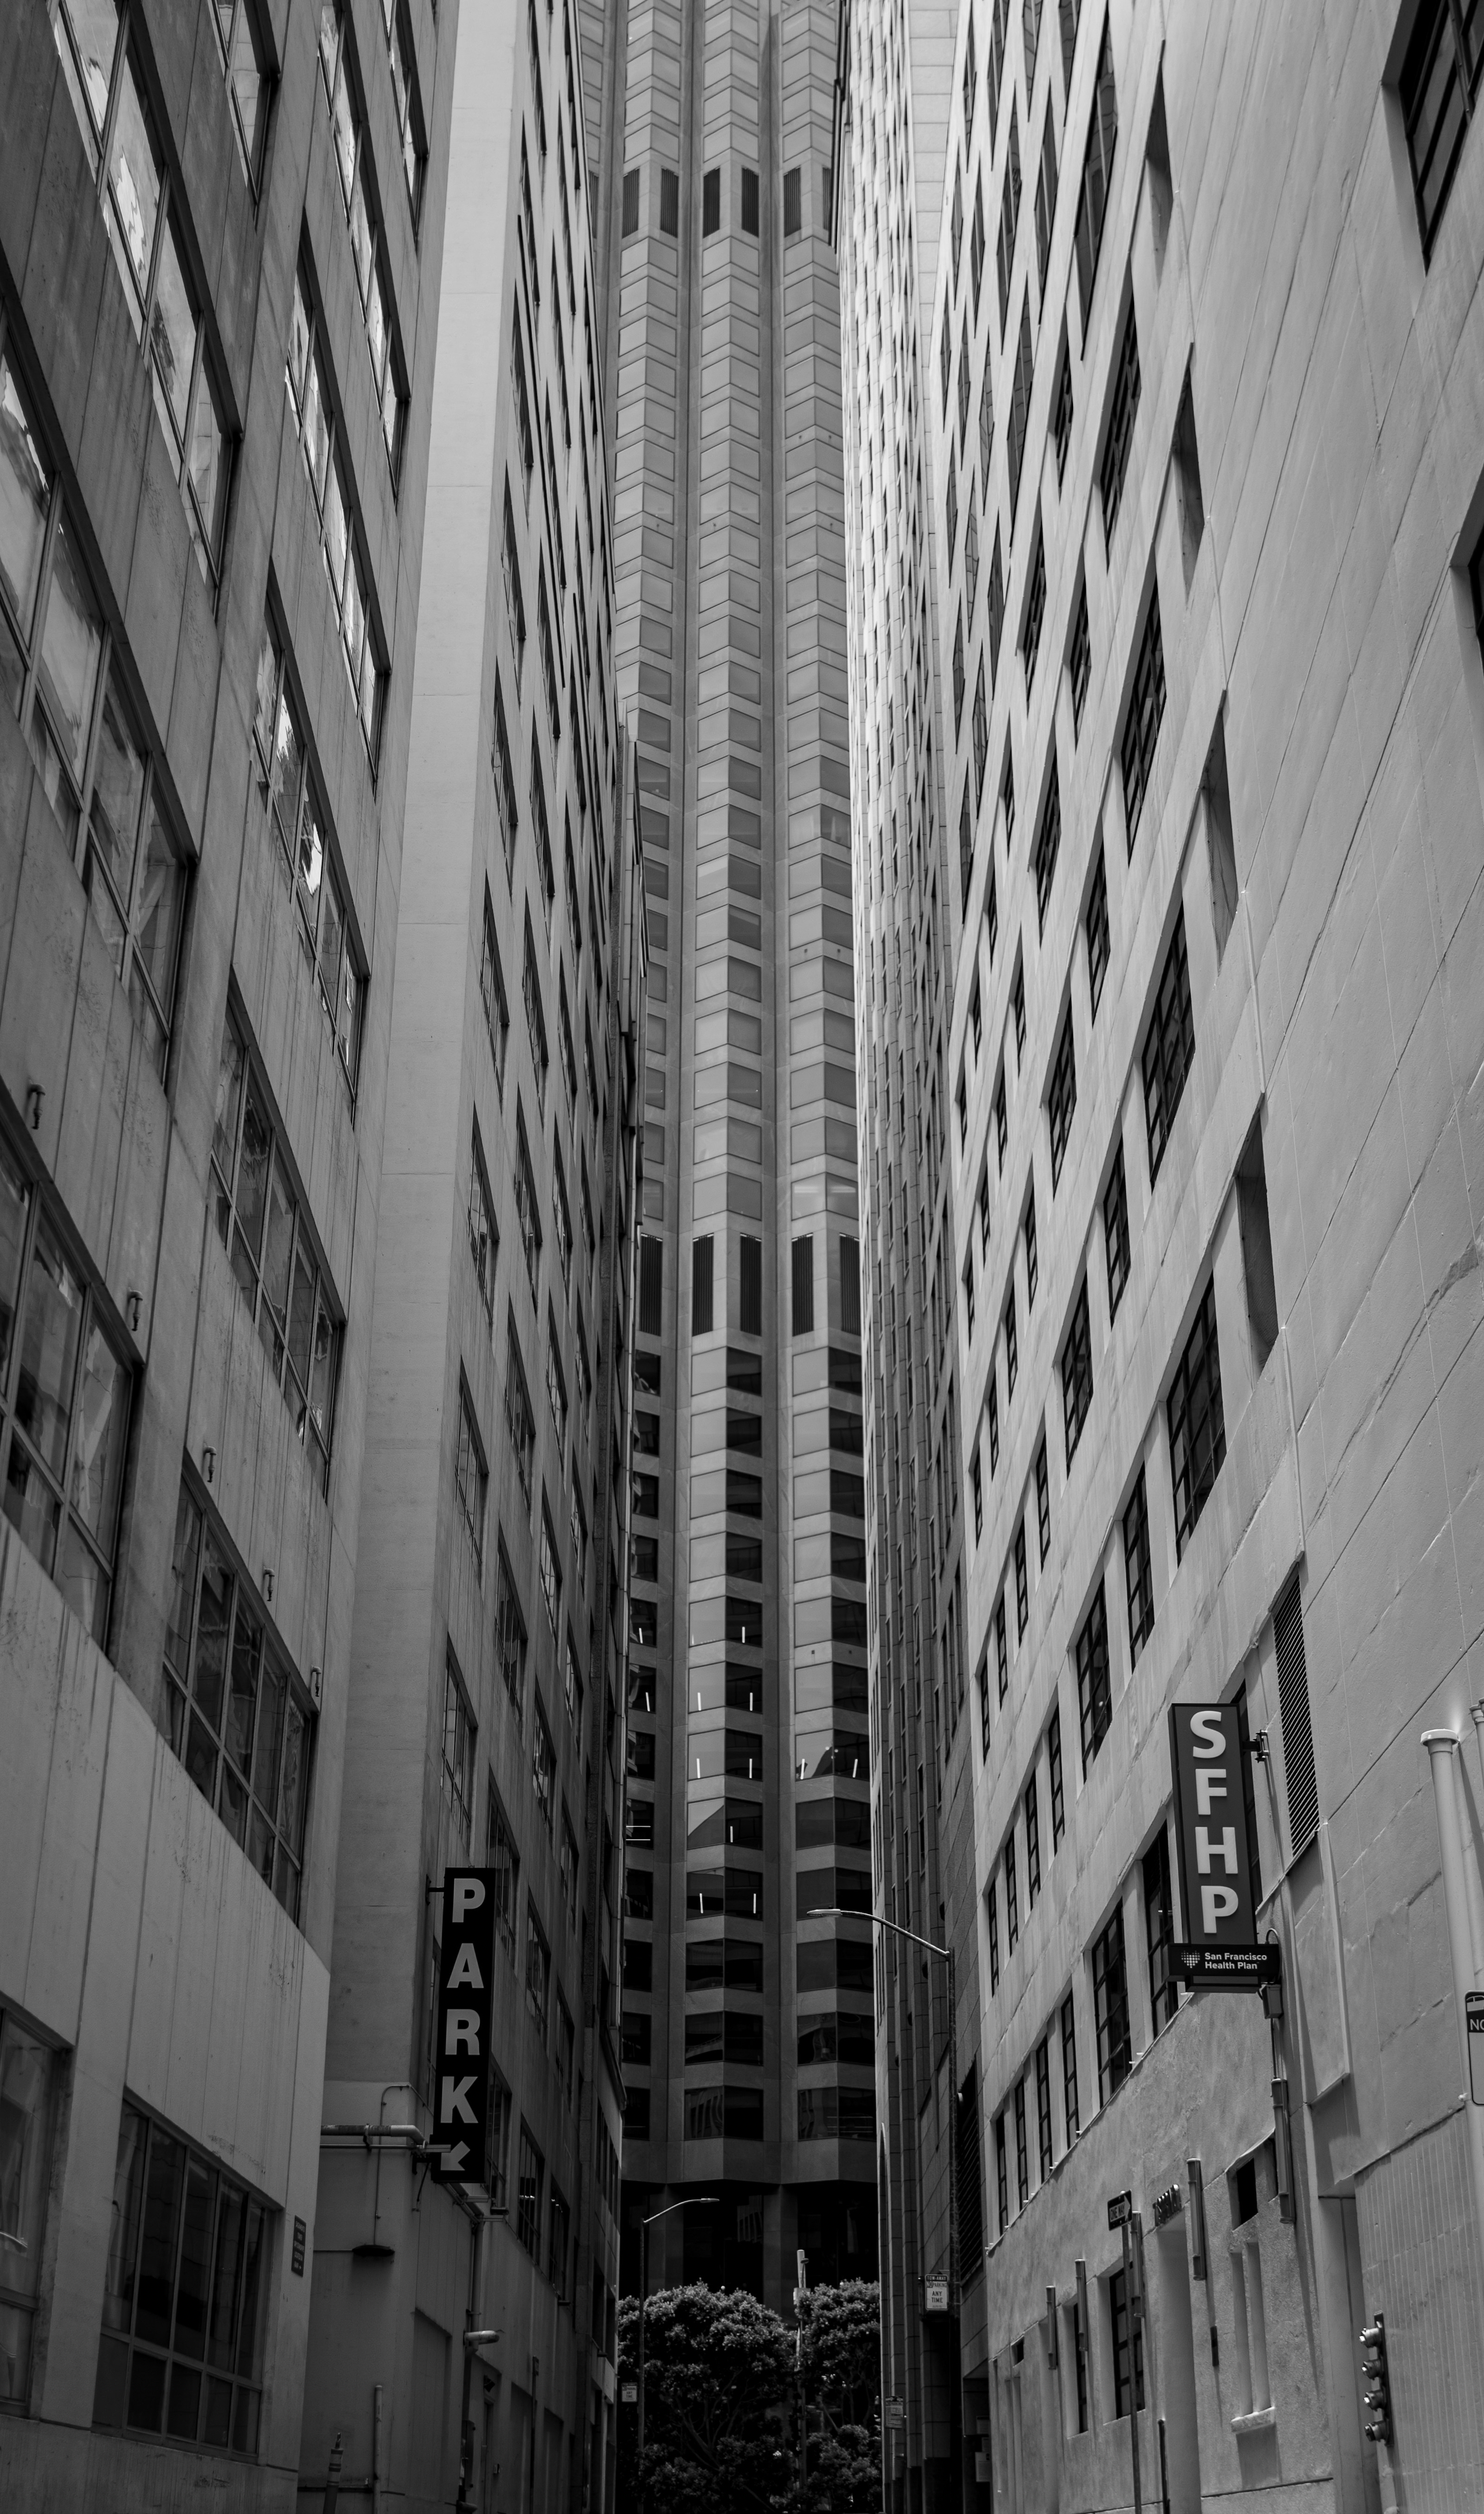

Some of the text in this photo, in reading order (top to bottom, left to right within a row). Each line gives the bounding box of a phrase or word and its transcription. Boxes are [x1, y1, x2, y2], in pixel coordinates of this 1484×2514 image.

[1189, 1710, 1240, 1934] SFHP
[440, 1877, 486, 2124] PARK
[1225, 1952, 1267, 1961] Francisco
